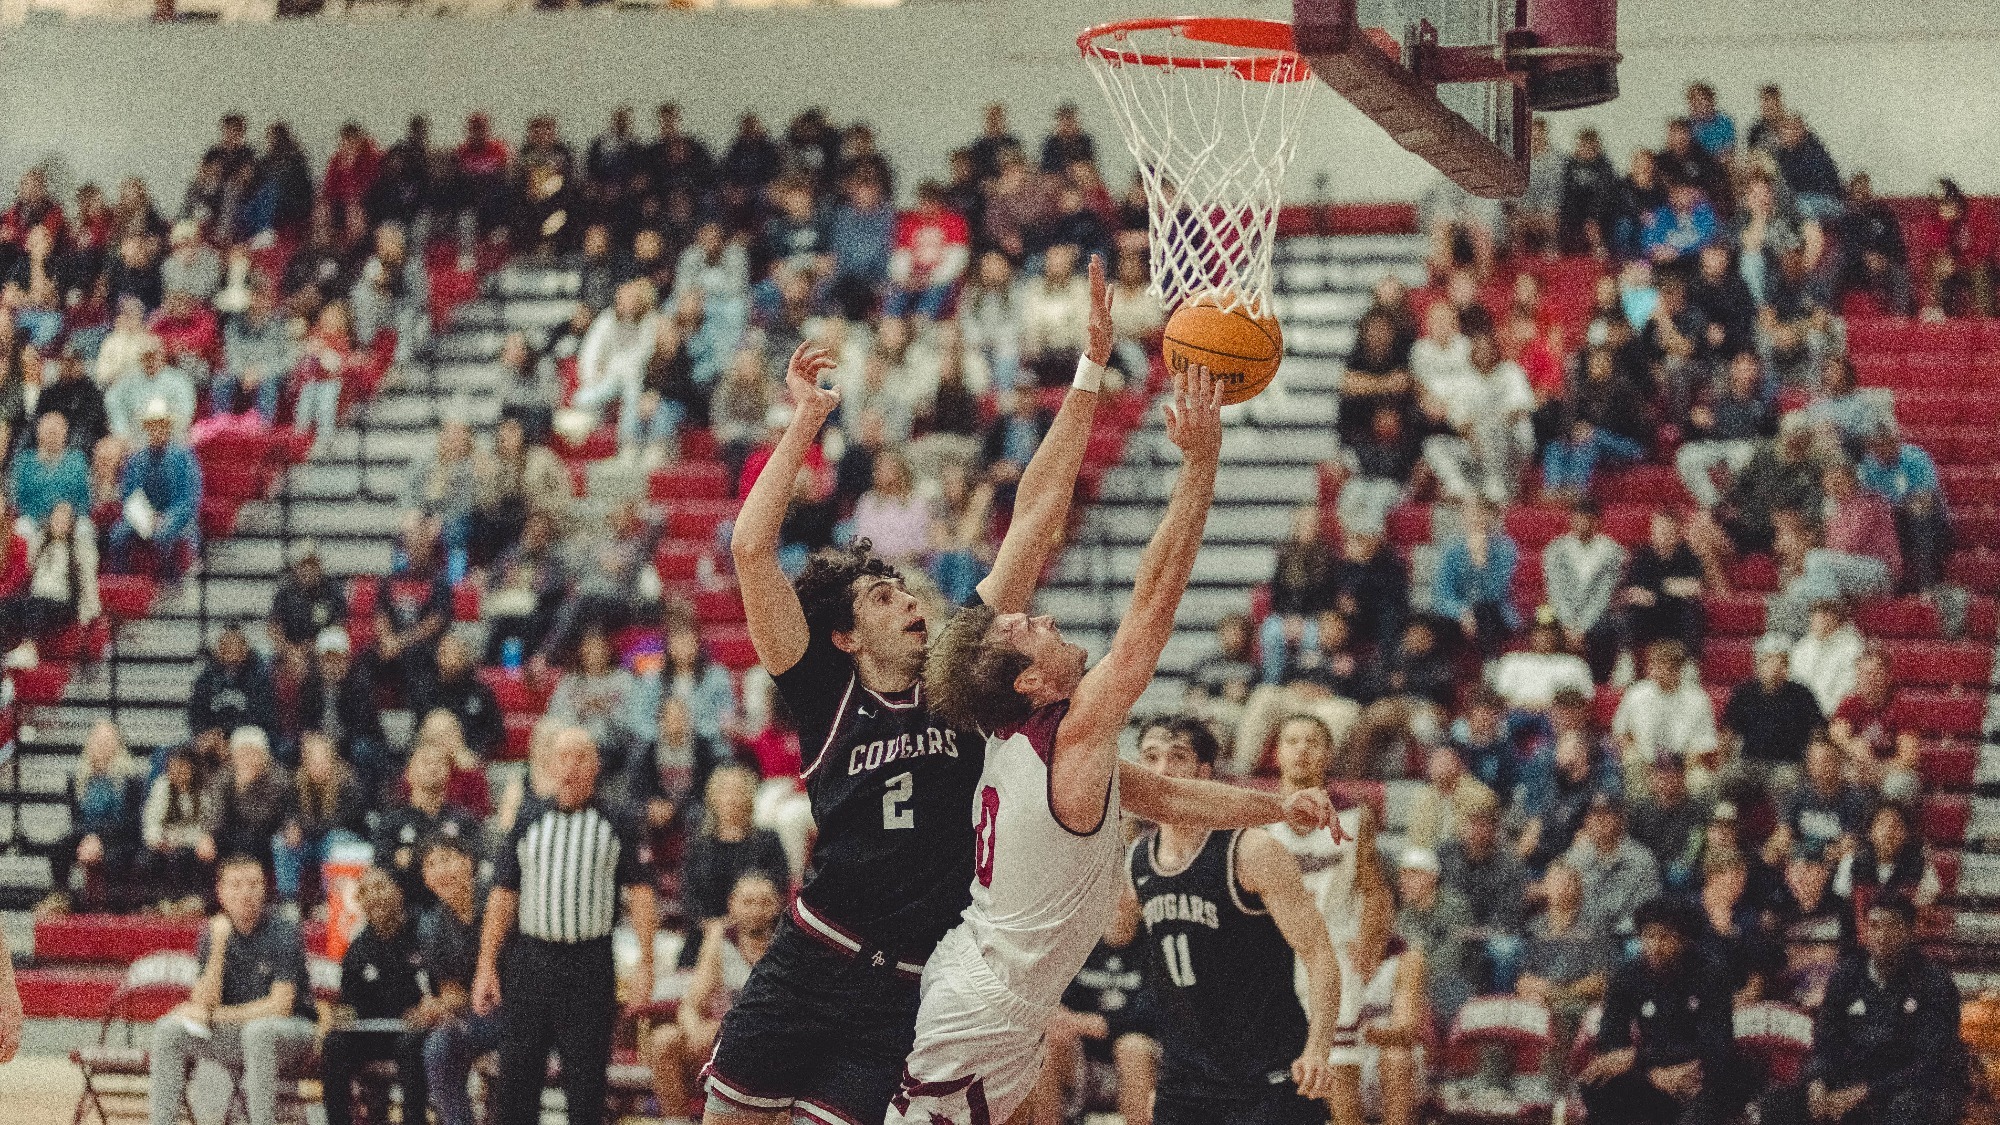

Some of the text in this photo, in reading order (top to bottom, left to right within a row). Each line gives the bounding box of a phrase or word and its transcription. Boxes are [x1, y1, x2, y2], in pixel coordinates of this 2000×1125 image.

[848, 727, 959, 776] COUGARS
[882, 771, 915, 830] 2
[1161, 932, 1197, 988] 11
